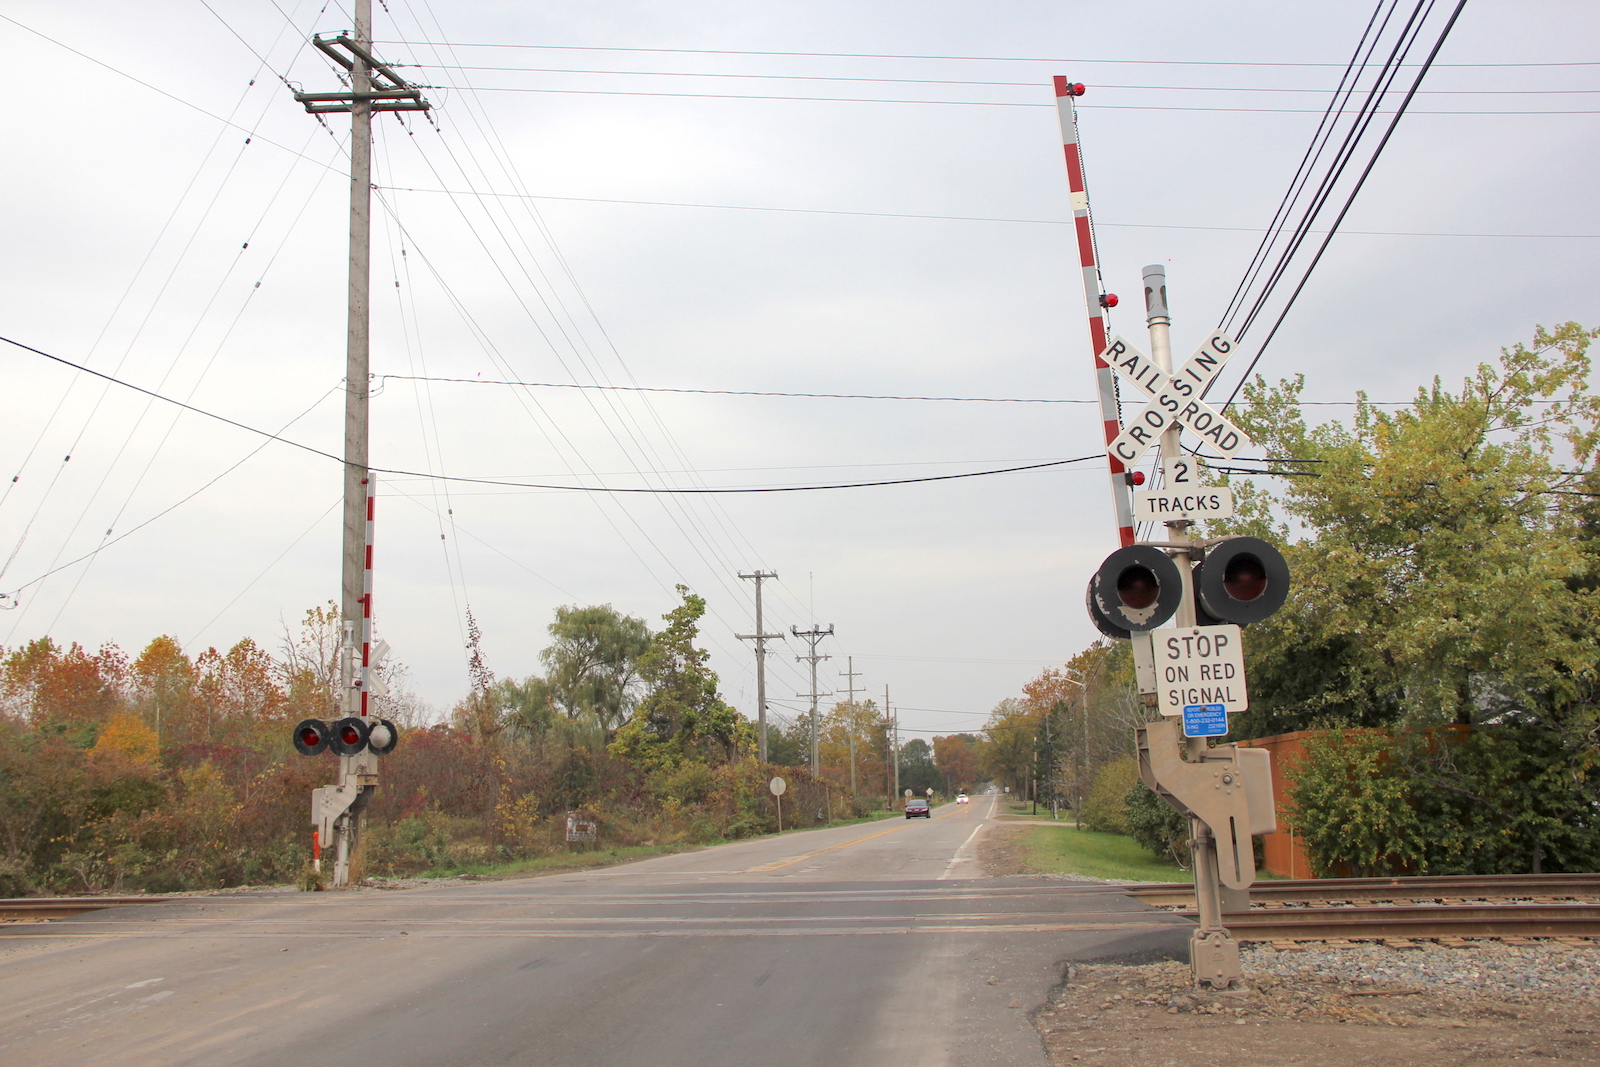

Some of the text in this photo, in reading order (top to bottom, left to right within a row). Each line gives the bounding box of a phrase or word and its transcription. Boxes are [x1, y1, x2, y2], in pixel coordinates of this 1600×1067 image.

[1106, 340, 1239, 451] RAIL ROAD
[1116, 336, 1231, 460] CROSSING
[1174, 462, 1189, 482] 2
[1147, 495, 1220, 513] TRACKS
[1167, 634, 1228, 660] STOP
[1165, 663, 1235, 683] ON RED
[1169, 686, 1237, 706] SIGNAL
